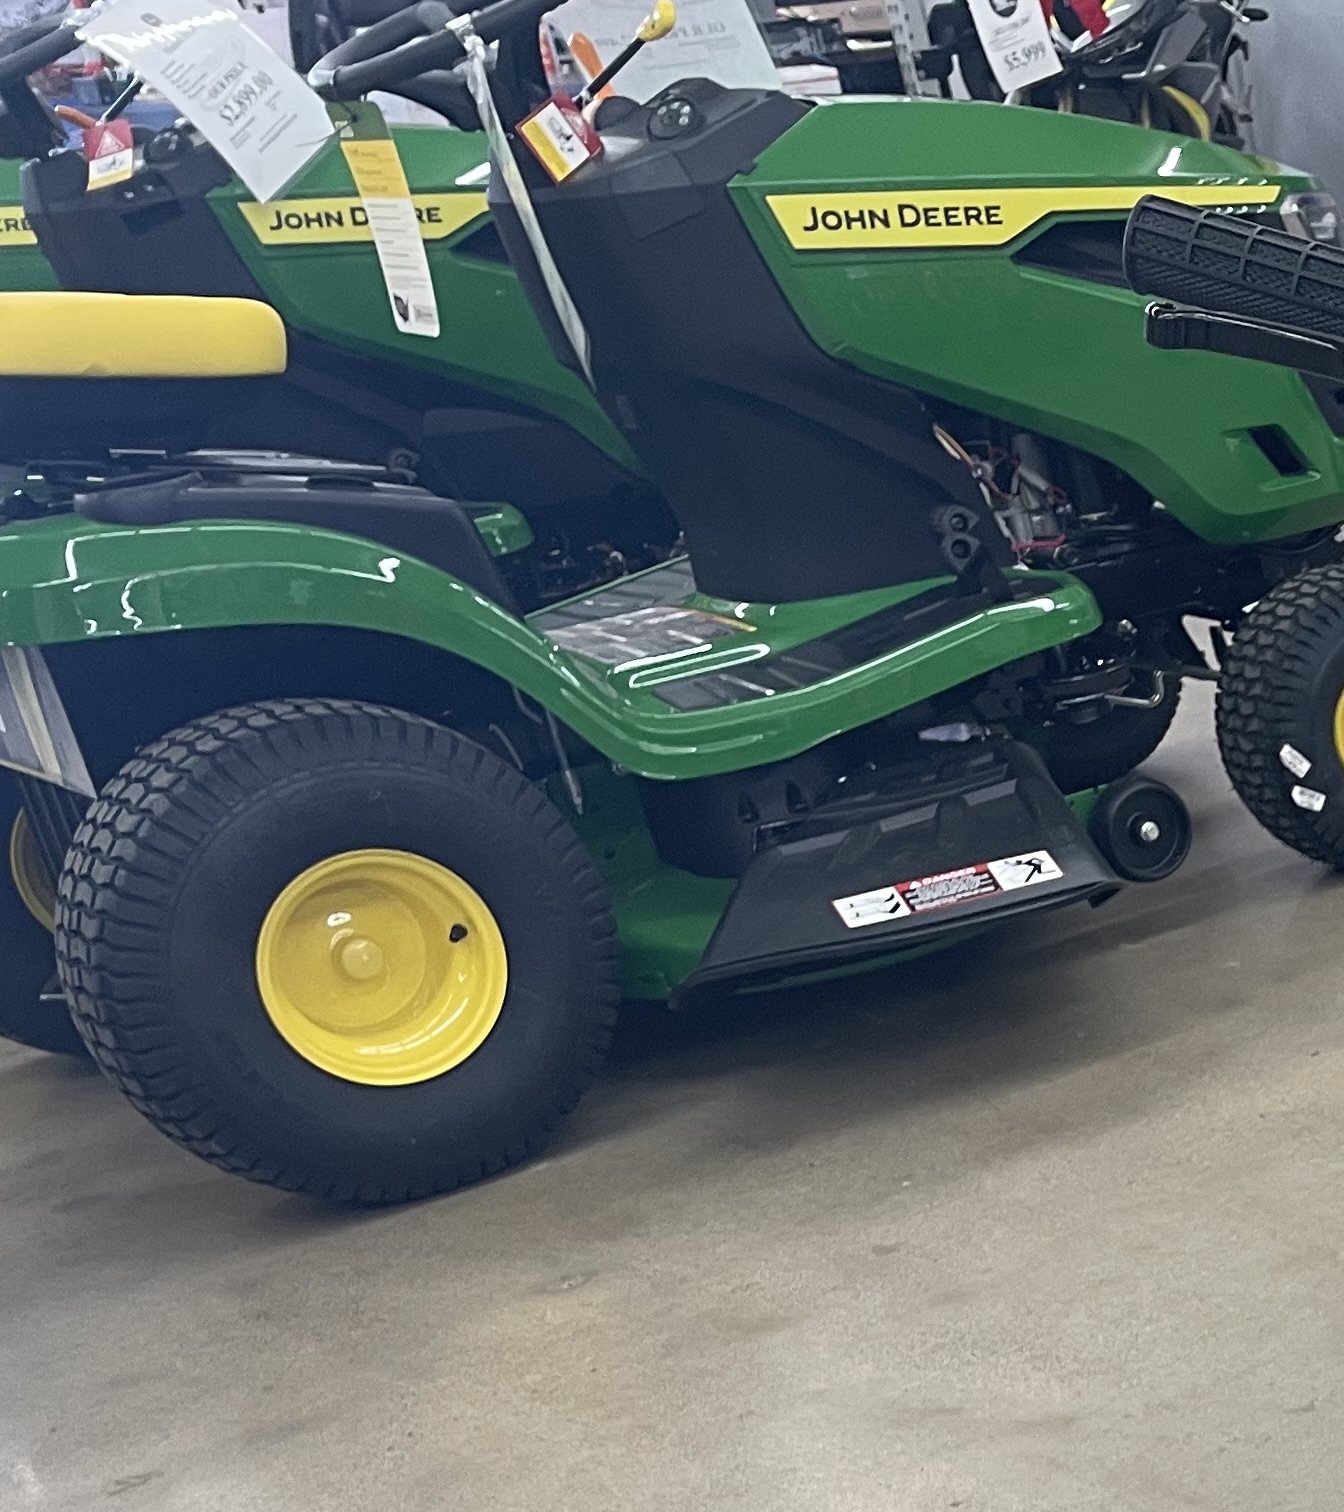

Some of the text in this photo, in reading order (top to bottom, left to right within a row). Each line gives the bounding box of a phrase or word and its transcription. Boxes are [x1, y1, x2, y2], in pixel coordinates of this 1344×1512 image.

[269, 206, 442, 231] JOHN DRE
[803, 204, 1004, 232] JOHN DEERE
